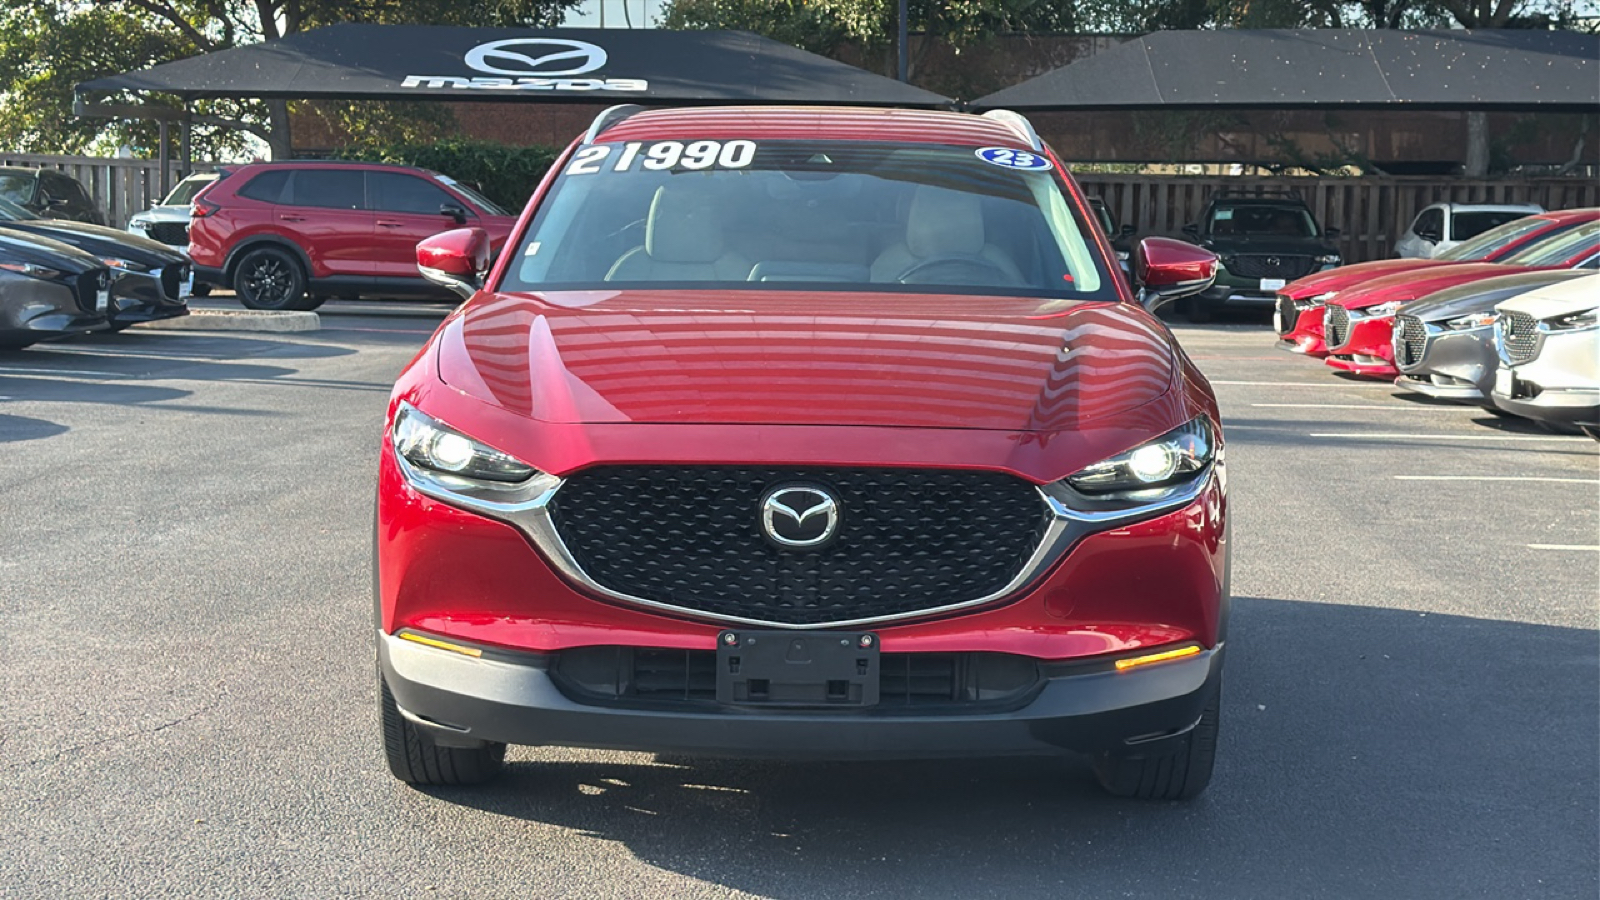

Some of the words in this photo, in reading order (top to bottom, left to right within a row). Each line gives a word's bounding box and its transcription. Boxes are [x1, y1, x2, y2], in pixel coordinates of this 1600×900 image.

[400, 75, 648, 91] mazda
[565, 139, 757, 175] 21990
[992, 149, 1035, 167] 23
